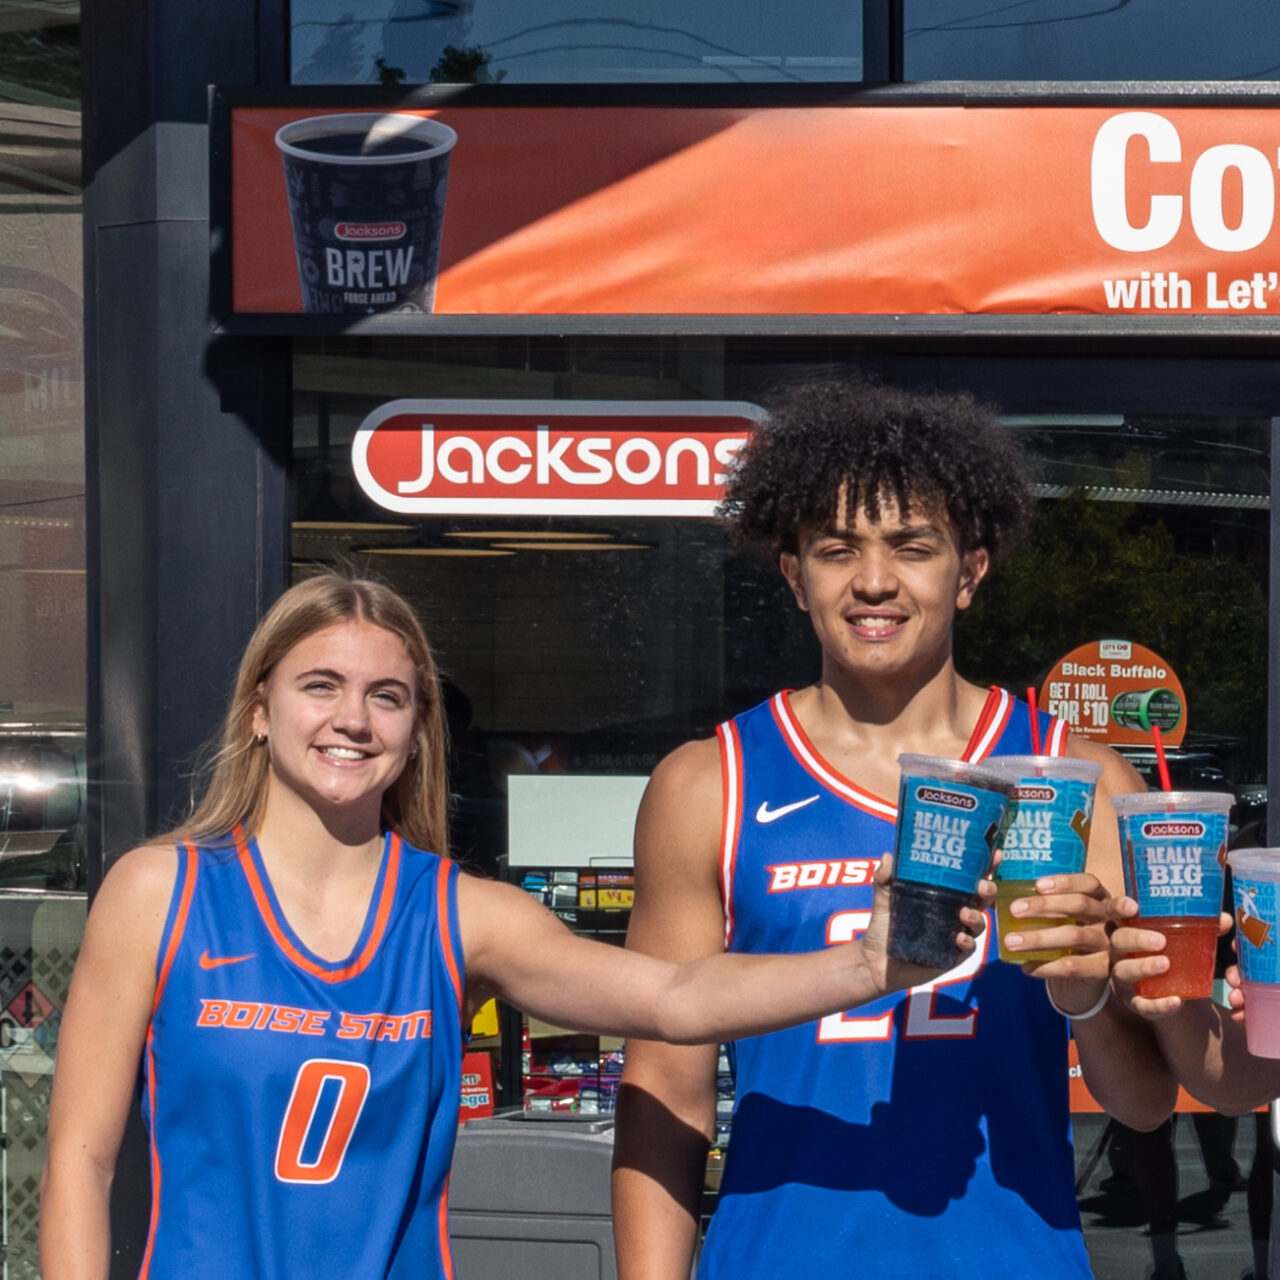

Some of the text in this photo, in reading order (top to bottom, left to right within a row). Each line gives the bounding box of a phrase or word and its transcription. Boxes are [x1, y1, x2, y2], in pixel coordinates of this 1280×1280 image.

[342, 224, 402, 237] Jacksons
[326, 246, 414, 288] BREW
[1103, 271, 1192, 310] with
[1061, 662, 1167, 680] Black Buffalo
[1050, 682, 1108, 700] GET 1 ROLL
[1083, 701, 1109, 726] $10
[922, 789, 972, 808] Jacksons
[914, 811, 970, 836] REALLY
[1149, 823, 1200, 835] Jacksons
[912, 829, 966, 858] BIG
[1003, 829, 1054, 849] BIG
[910, 850, 962, 870] DRINK
[1003, 850, 1053, 861] DRINK
[1147, 846, 1202, 864] REALLY
[1149, 864, 1204, 885] BIG
[1149, 885, 1204, 898] DRINK
[196, 999, 331, 1036] BOISE
[275, 1058, 371, 1185] 0
